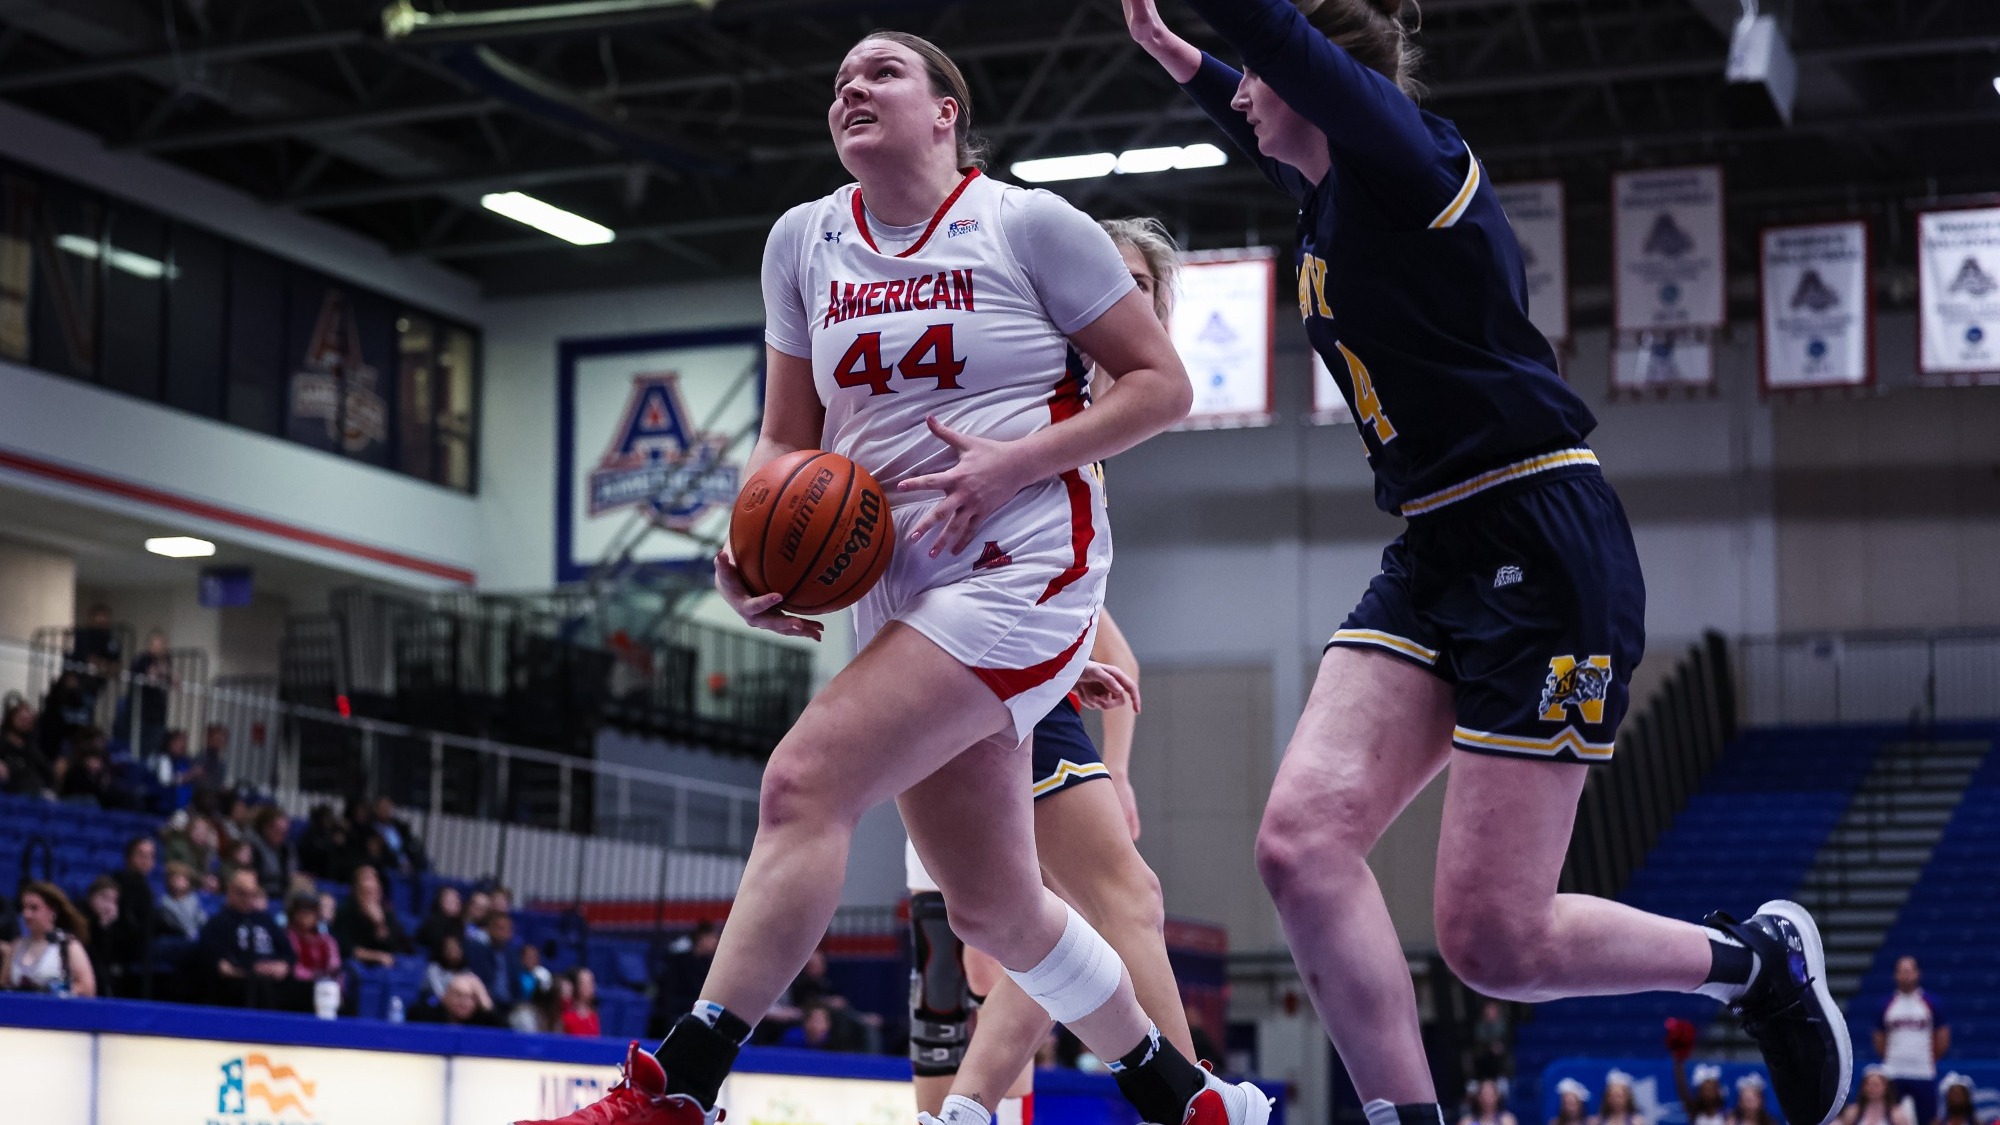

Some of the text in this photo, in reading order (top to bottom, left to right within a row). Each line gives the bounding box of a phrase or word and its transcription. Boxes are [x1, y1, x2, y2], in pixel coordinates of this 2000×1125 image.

[823, 268, 975, 330] AMERICAN
[833, 323, 967, 396] 44
[1335, 340, 1398, 457] 4
[783, 468, 834, 563] EVOLUTION
[818, 488, 880, 586] Wilson
